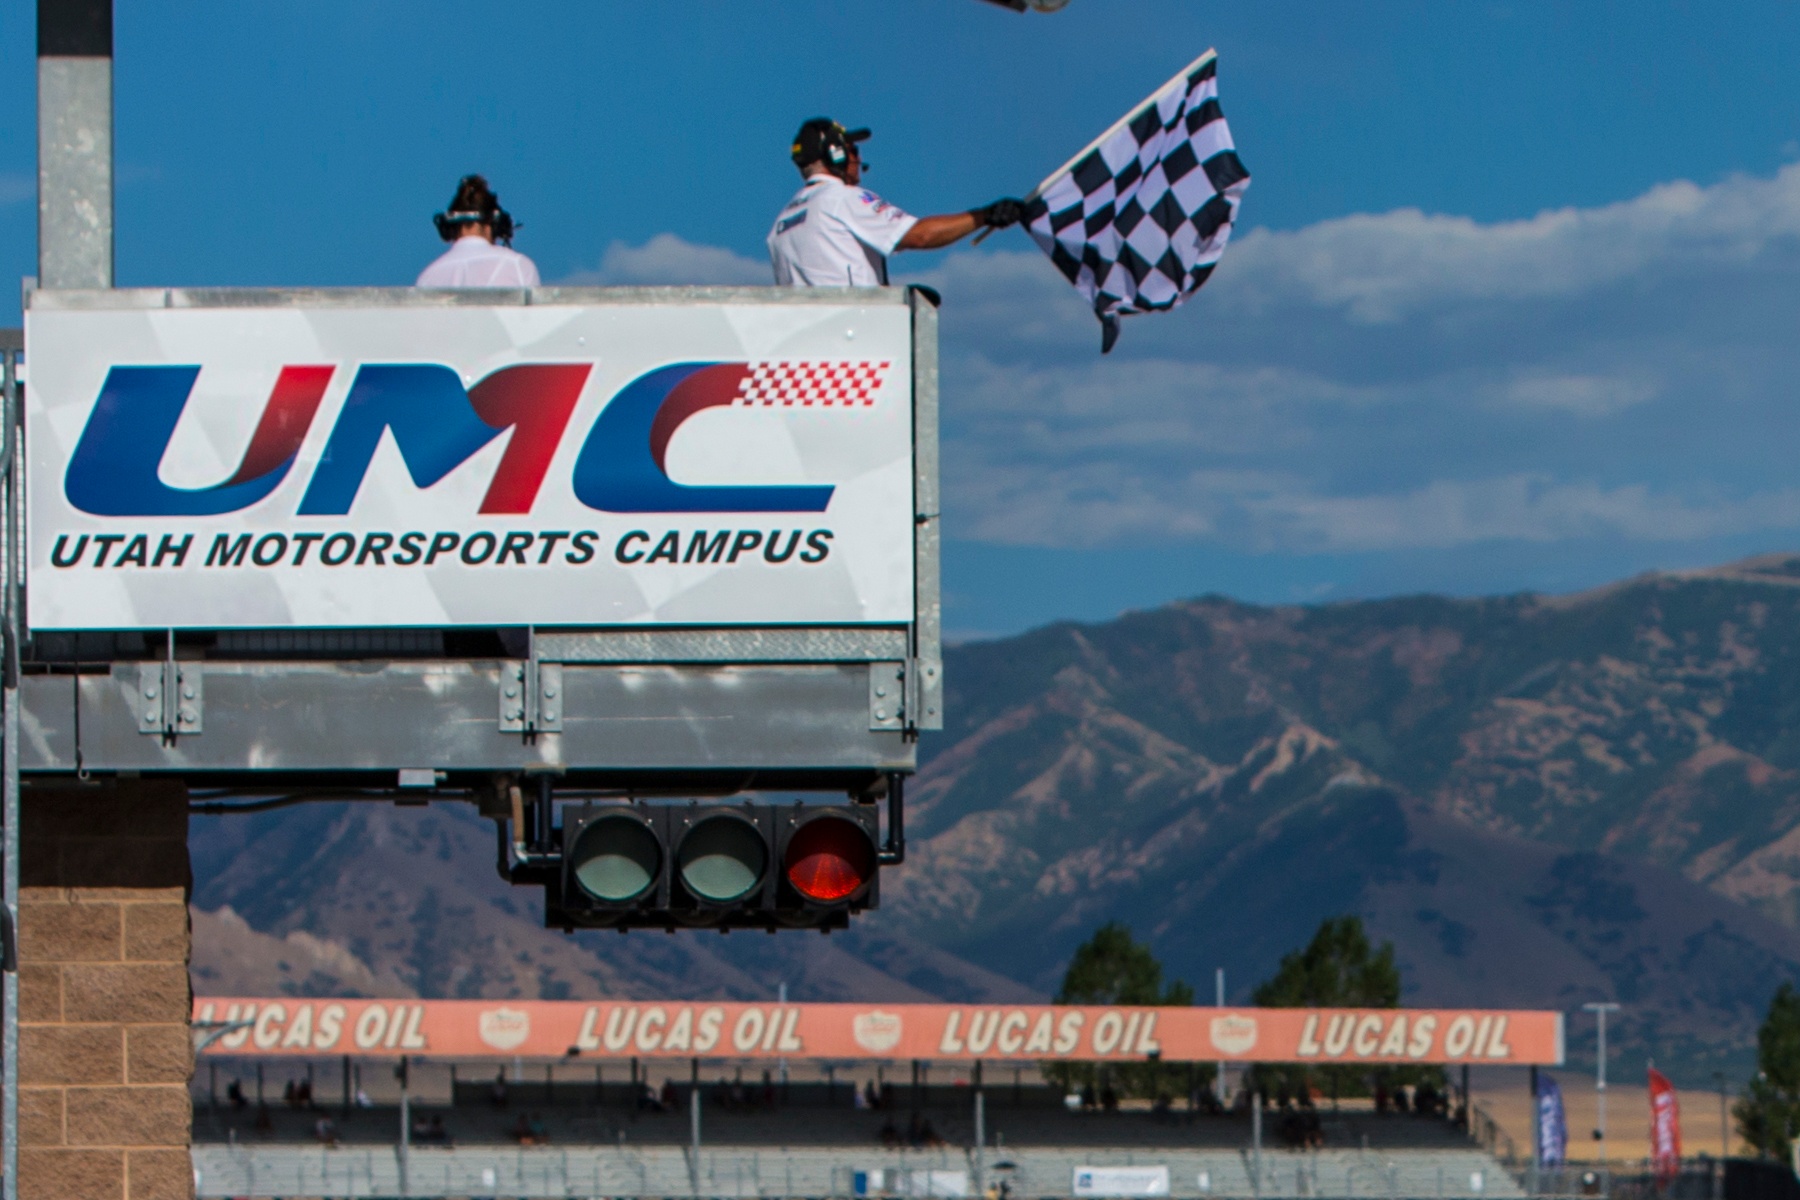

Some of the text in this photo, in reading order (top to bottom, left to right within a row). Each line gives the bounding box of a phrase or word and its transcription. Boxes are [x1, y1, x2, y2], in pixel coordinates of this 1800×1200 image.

[64, 361, 890, 517] UMC
[50, 529, 835, 568] UTAH MOTORSPORTS CAMPUS
[354, 1003, 426, 1049] OIL
[577, 1005, 724, 1052] LUCAS
[732, 1007, 801, 1053] OIL
[939, 1009, 1085, 1055] LUCAS
[1092, 1011, 1160, 1056] OIL
[1298, 1014, 1437, 1059] LUCAS
[1445, 1014, 1510, 1059] OIL
